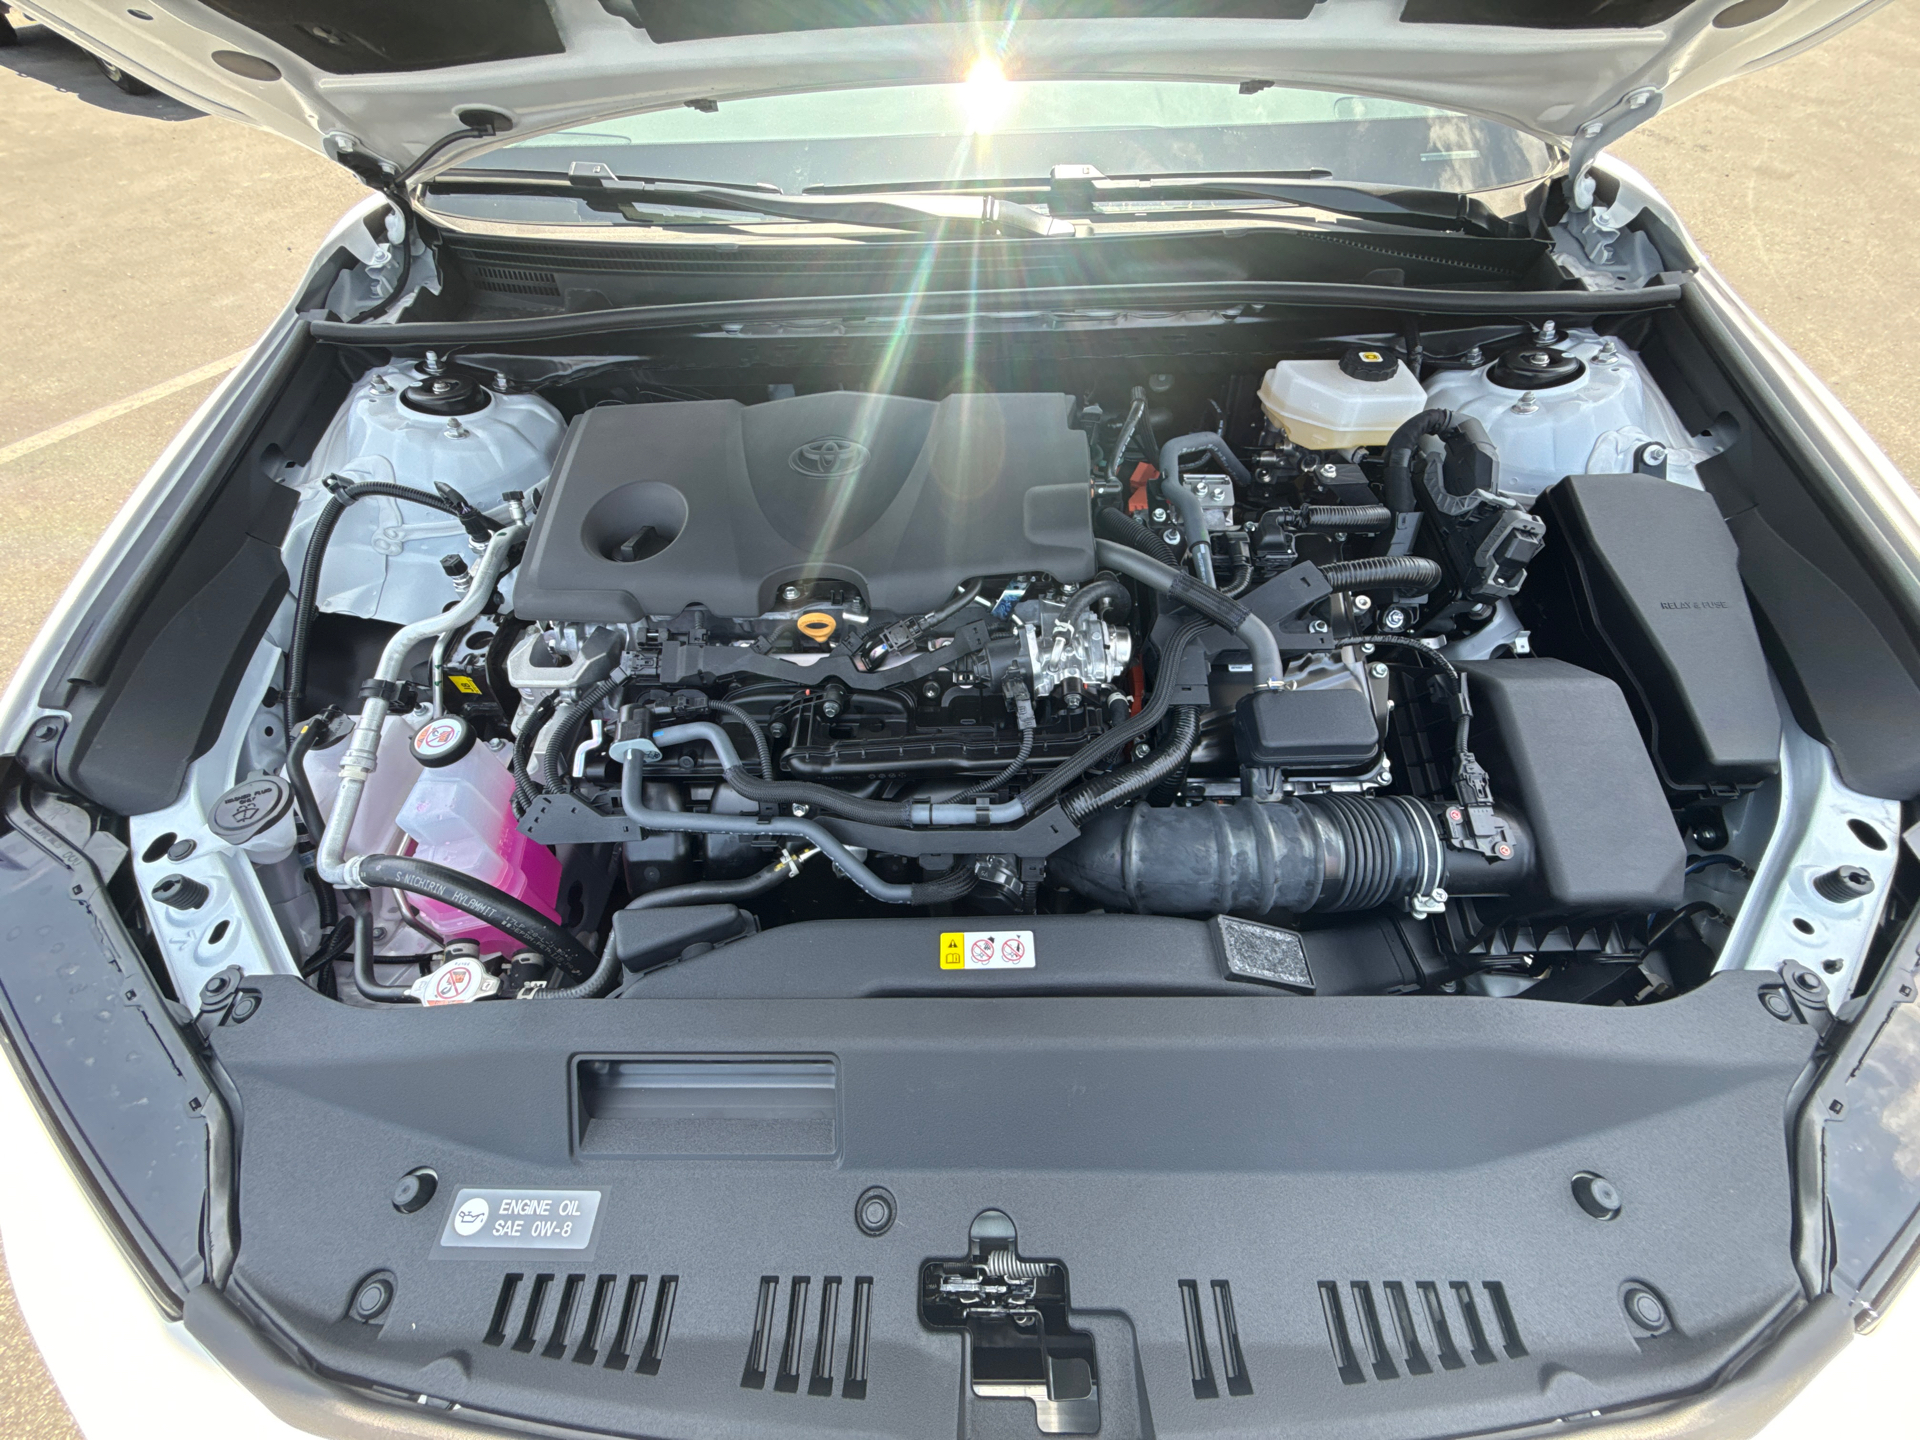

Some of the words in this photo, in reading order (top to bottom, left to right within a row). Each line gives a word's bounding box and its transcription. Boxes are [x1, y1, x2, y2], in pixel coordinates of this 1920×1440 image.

[1660, 601, 1691, 610] RELAY
[1702, 601, 1729, 609] FUSE
[452, 890, 498, 918] HYLAMMIT
[499, 1199, 552, 1215] ENGINE
[558, 1200, 581, 1216] OIL
[492, 1220, 524, 1237] SAE
[531, 1220, 573, 1237] 0W-8
